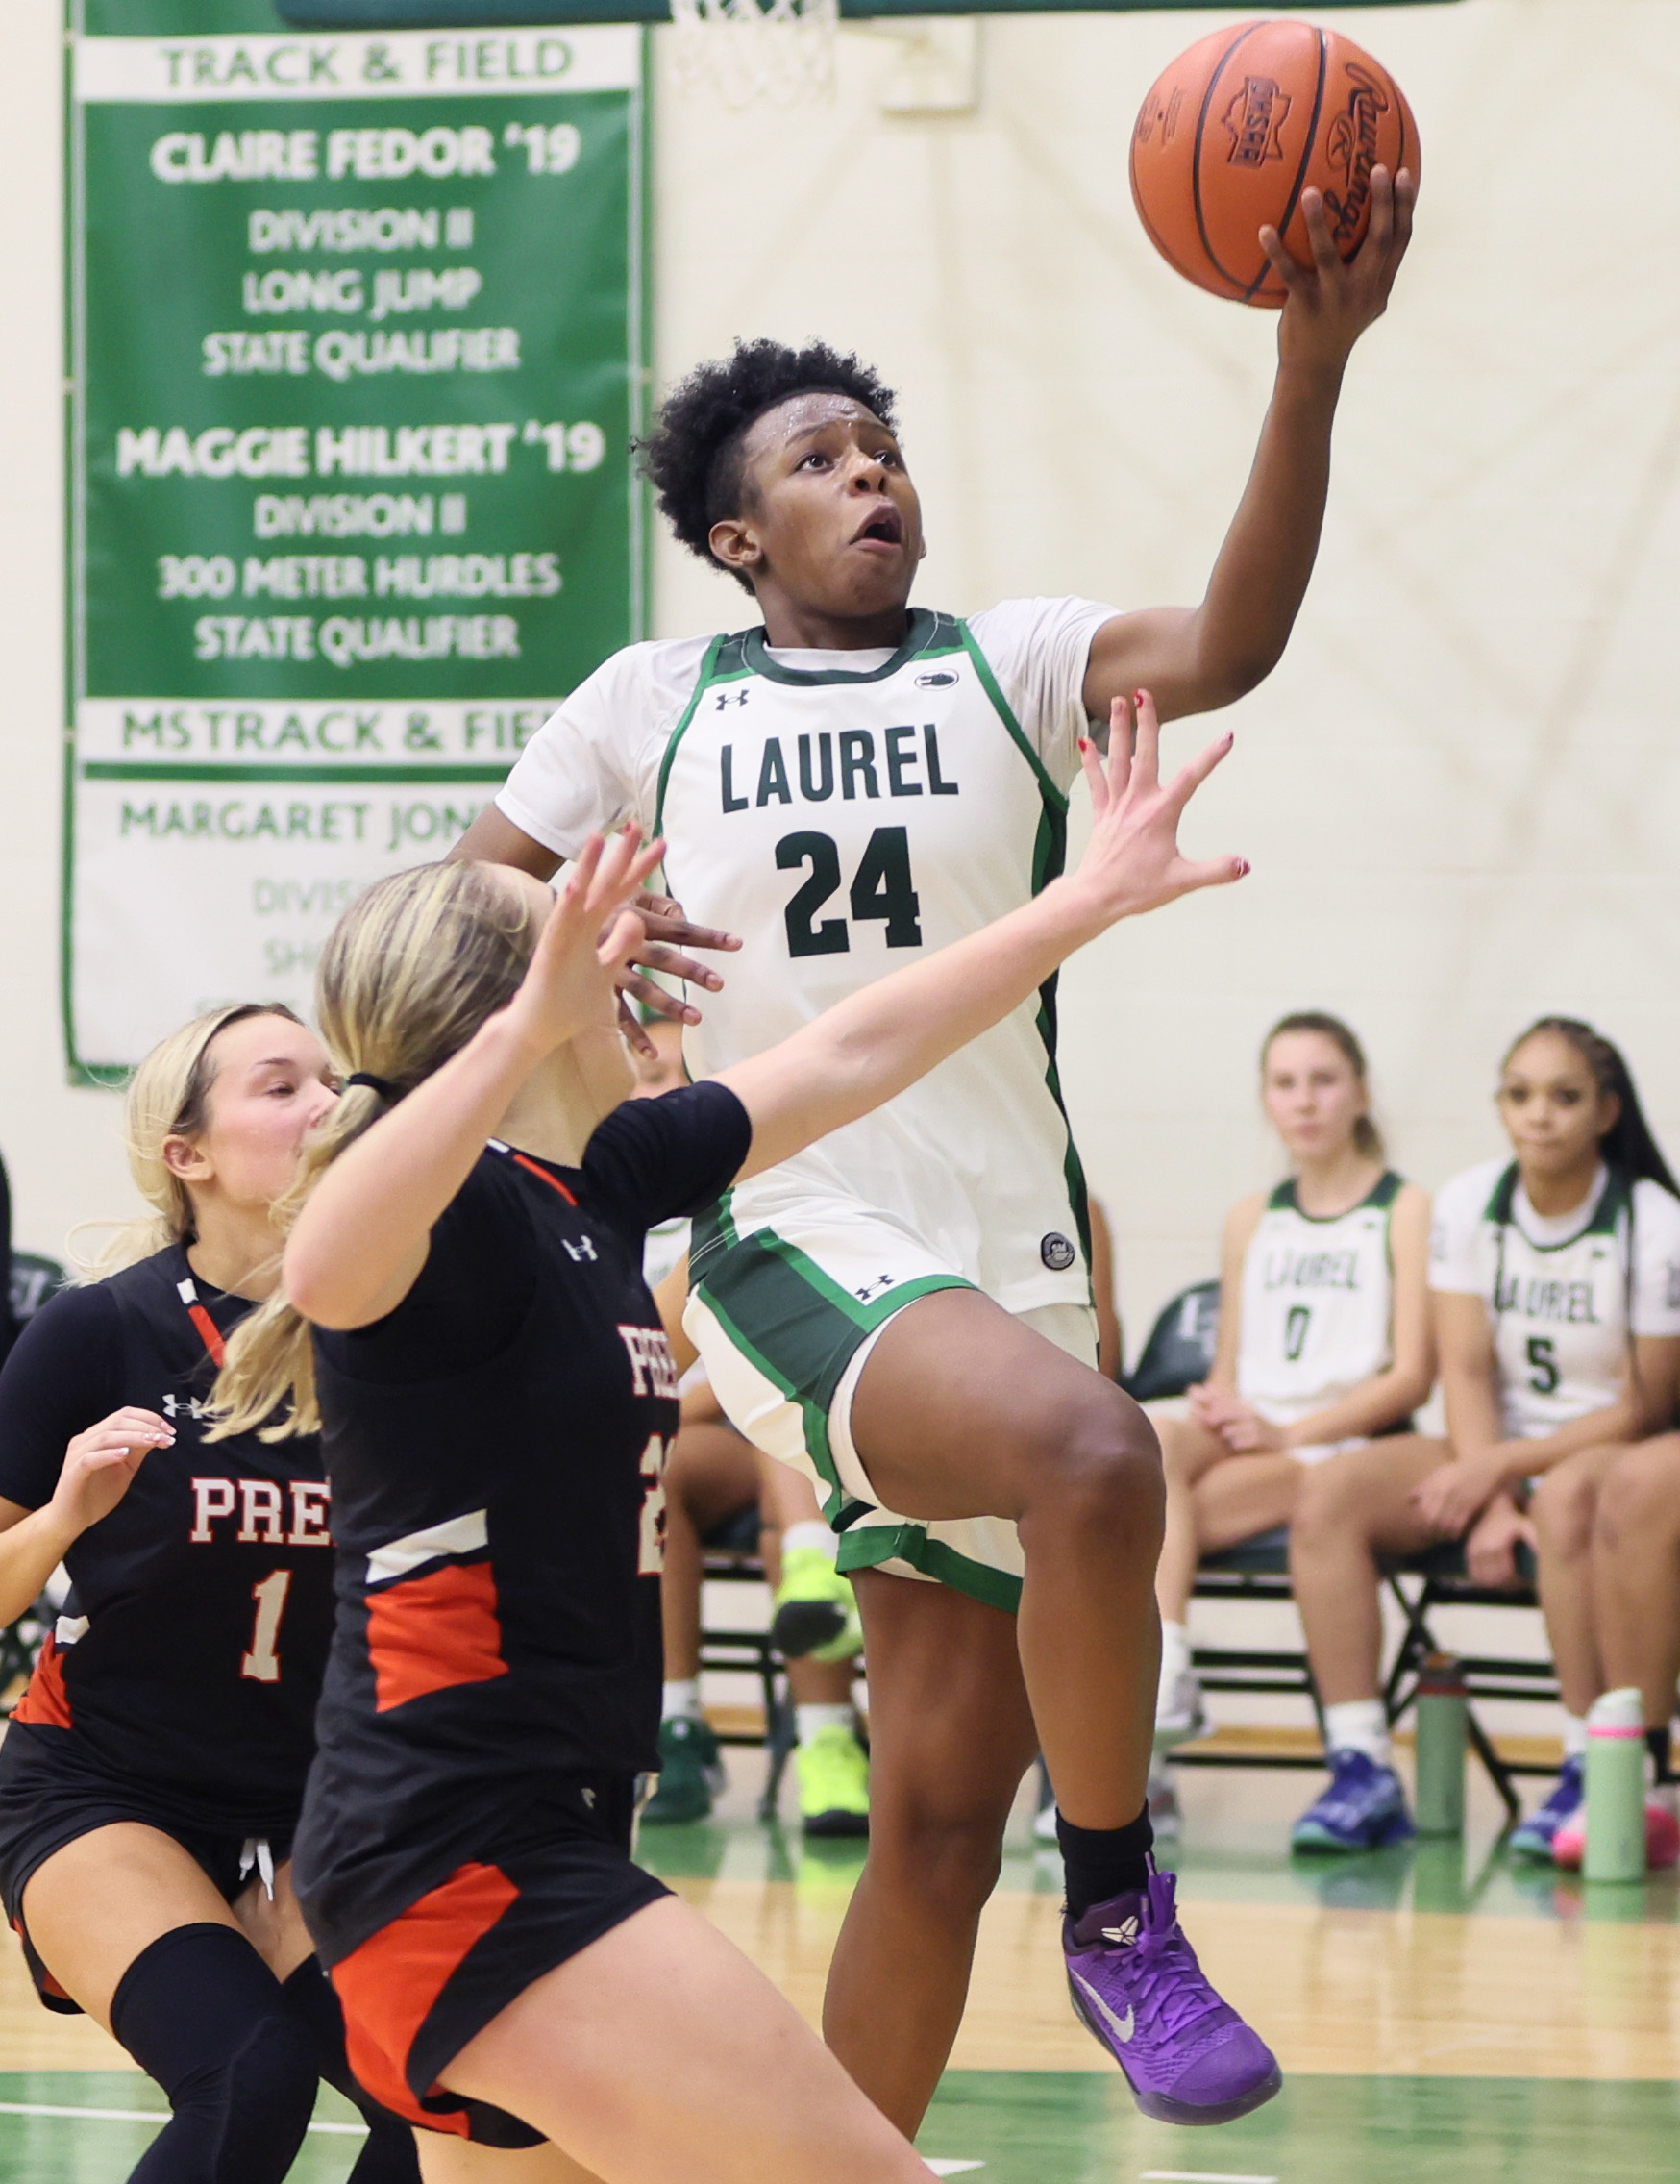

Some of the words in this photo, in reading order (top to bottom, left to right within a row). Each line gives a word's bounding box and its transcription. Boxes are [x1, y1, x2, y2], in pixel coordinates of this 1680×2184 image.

[160, 46, 338, 88] TRACK
[361, 44, 401, 83] &
[426, 39, 574, 81] FIELD
[151, 130, 319, 183] CLAIRE
[327, 126, 496, 180] FEDOR
[249, 208, 440, 253] DIVISION
[447, 209, 474, 248] II
[243, 270, 364, 313] LONG
[370, 268, 482, 321] JUMP
[203, 331, 310, 376] STATE
[314, 327, 521, 381] QUALIFIER
[117, 427, 309, 478] MAGGIE
[316, 423, 517, 476] HILKERT
[253, 494, 434, 538] DIVISION
[440, 494, 466, 534] II
[159, 555, 236, 599] 300
[243, 555, 368, 598] METER
[375, 553, 562, 597] HURDLES
[194, 615, 315, 660] STATE
[319, 614, 521, 666] QUALIFIER
[403, 712, 443, 751] &
[464, 711, 553, 751] FIE
[721, 723, 959, 814] LAUREL
[120, 802, 370, 842] MARGARET
[388, 803, 492, 851] JON
[775, 826, 923, 958] 24
[1264, 1249, 1359, 1290] LAUREL
[1526, 1335, 1559, 1394] 5
[190, 1477, 337, 1547] PRE
[239, 1569, 292, 1683] 1
